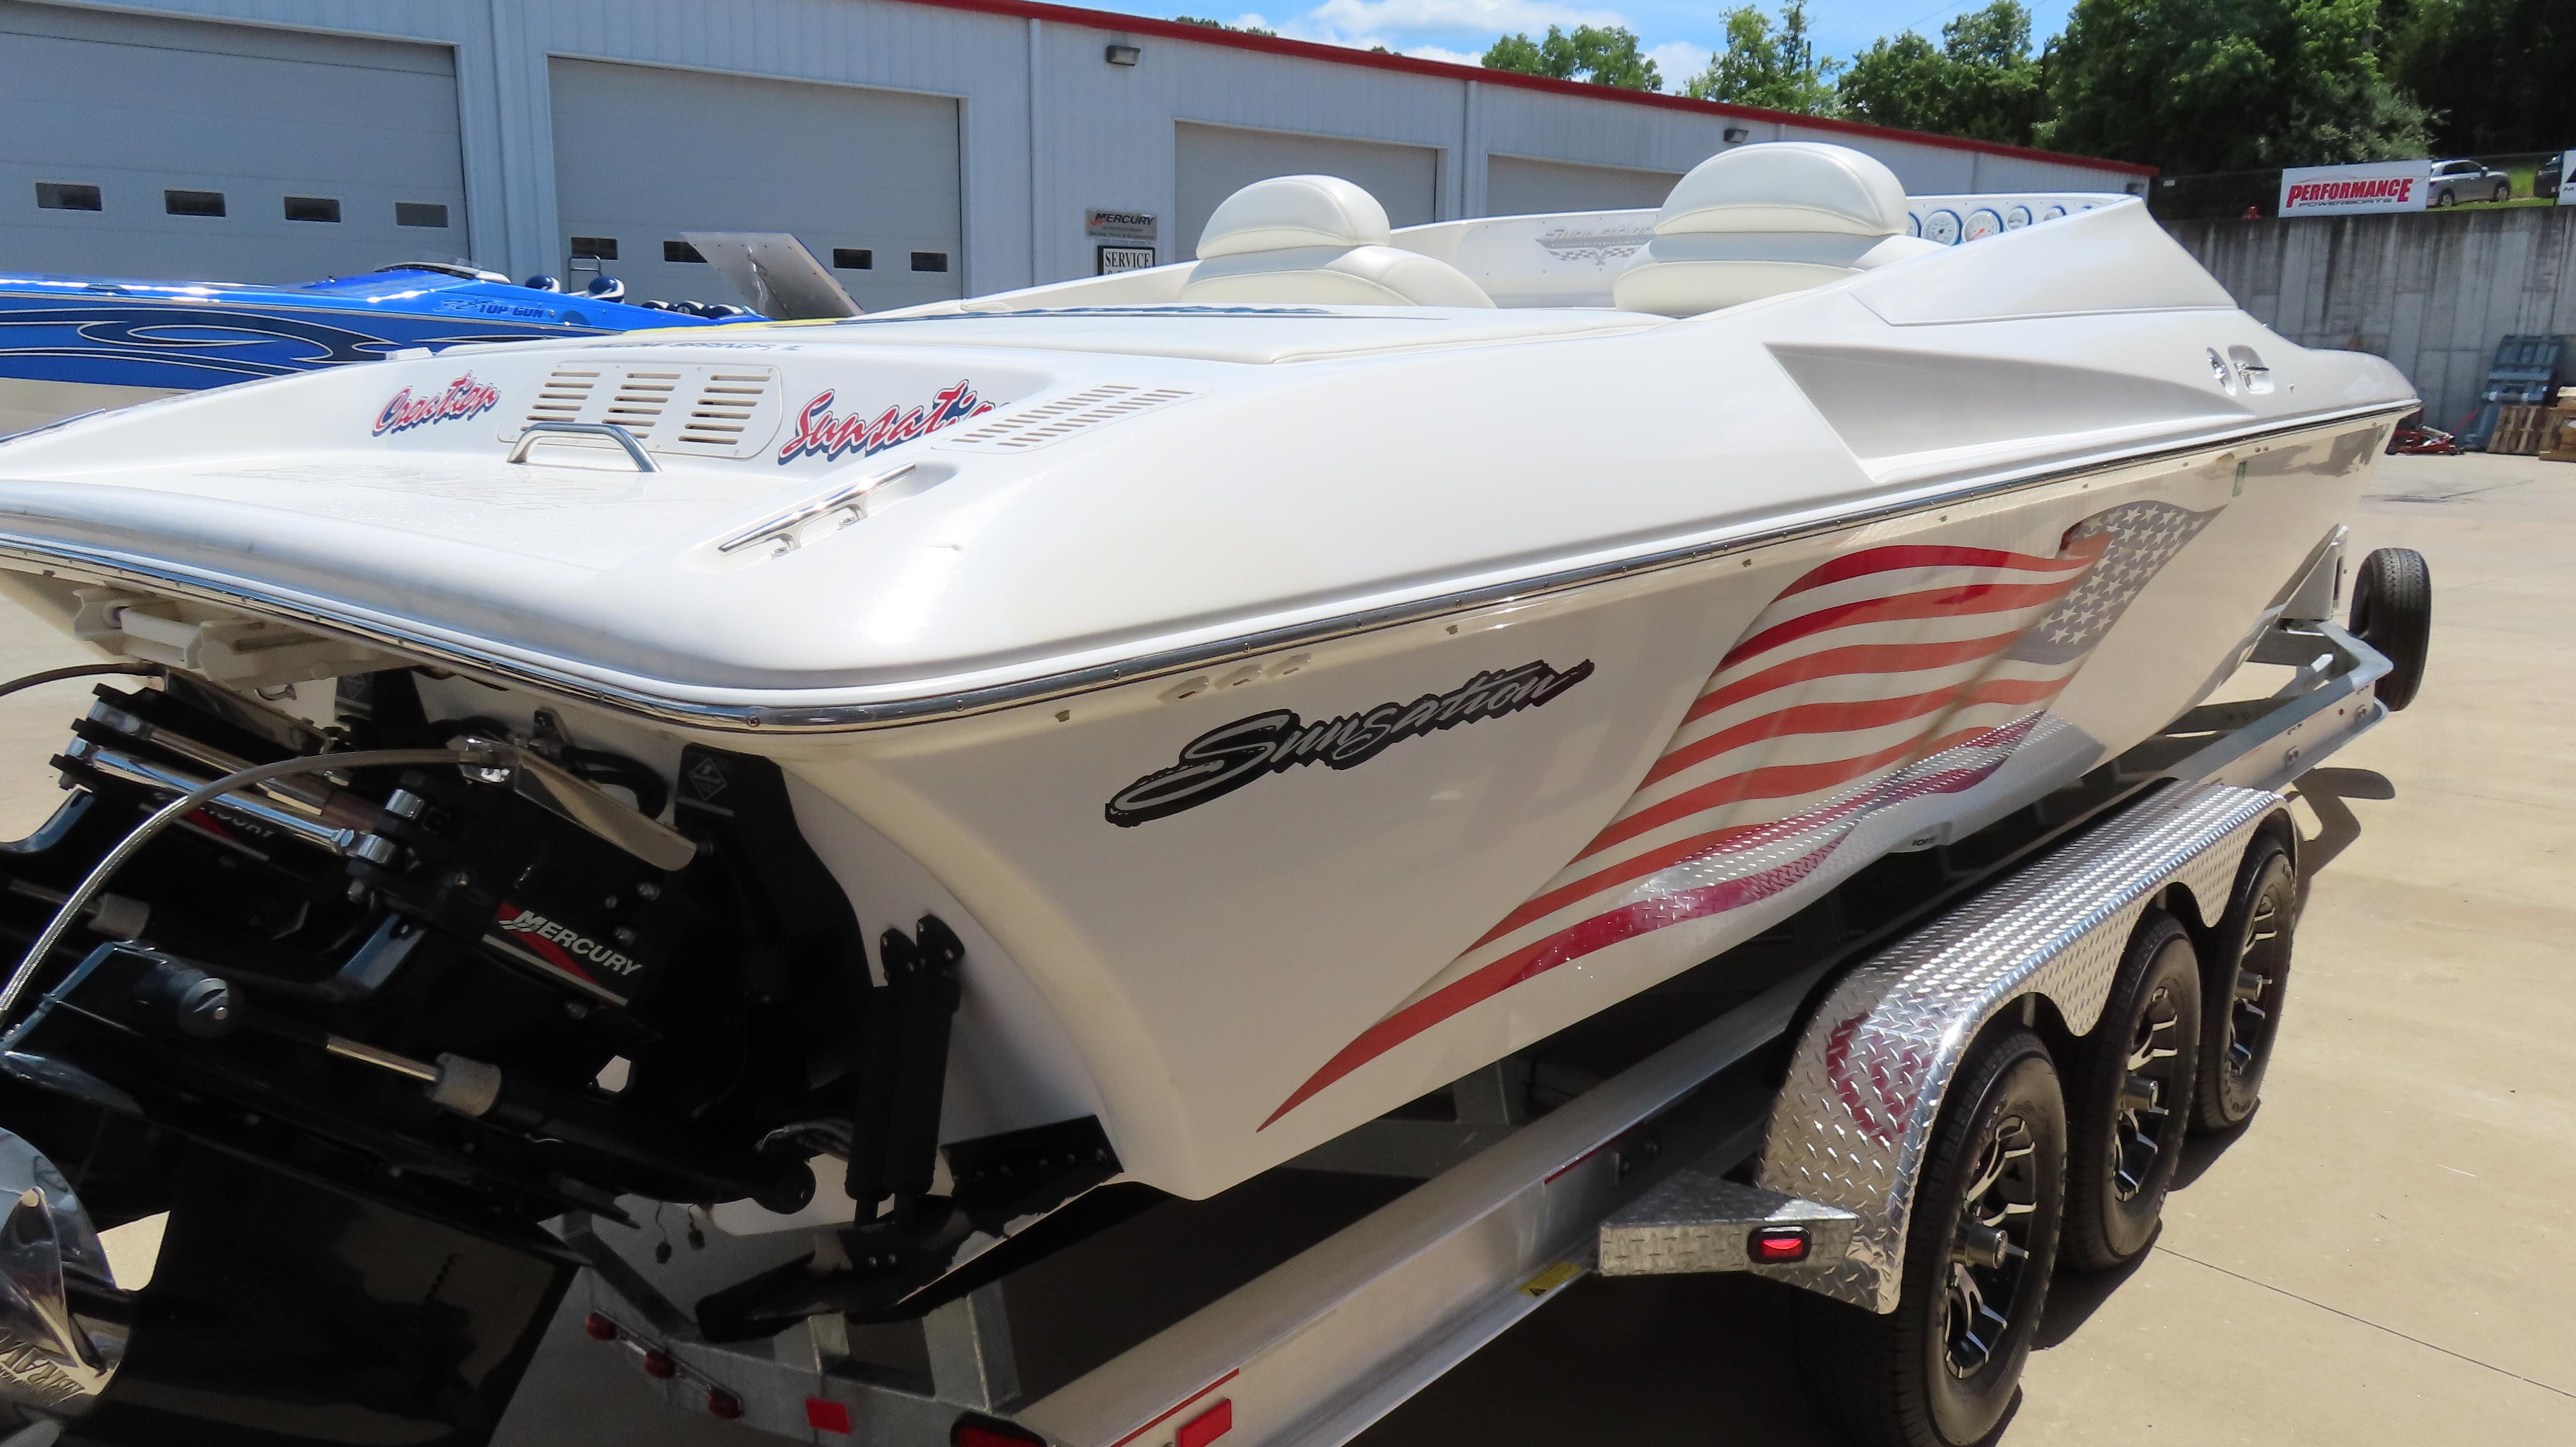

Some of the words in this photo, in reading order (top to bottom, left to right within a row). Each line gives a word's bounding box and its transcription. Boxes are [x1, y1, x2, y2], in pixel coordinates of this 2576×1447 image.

[2286, 178, 2414, 208] PERFORMANCE
[1091, 213, 1154, 226] MERCURY
[1105, 251, 1151, 268] SERVICE
[512, 307, 545, 318] GUN
[778, 379, 1010, 466] Sunsati
[1105, 659, 1595, 827] Sunsation
[498, 910, 643, 975] MERCURY
